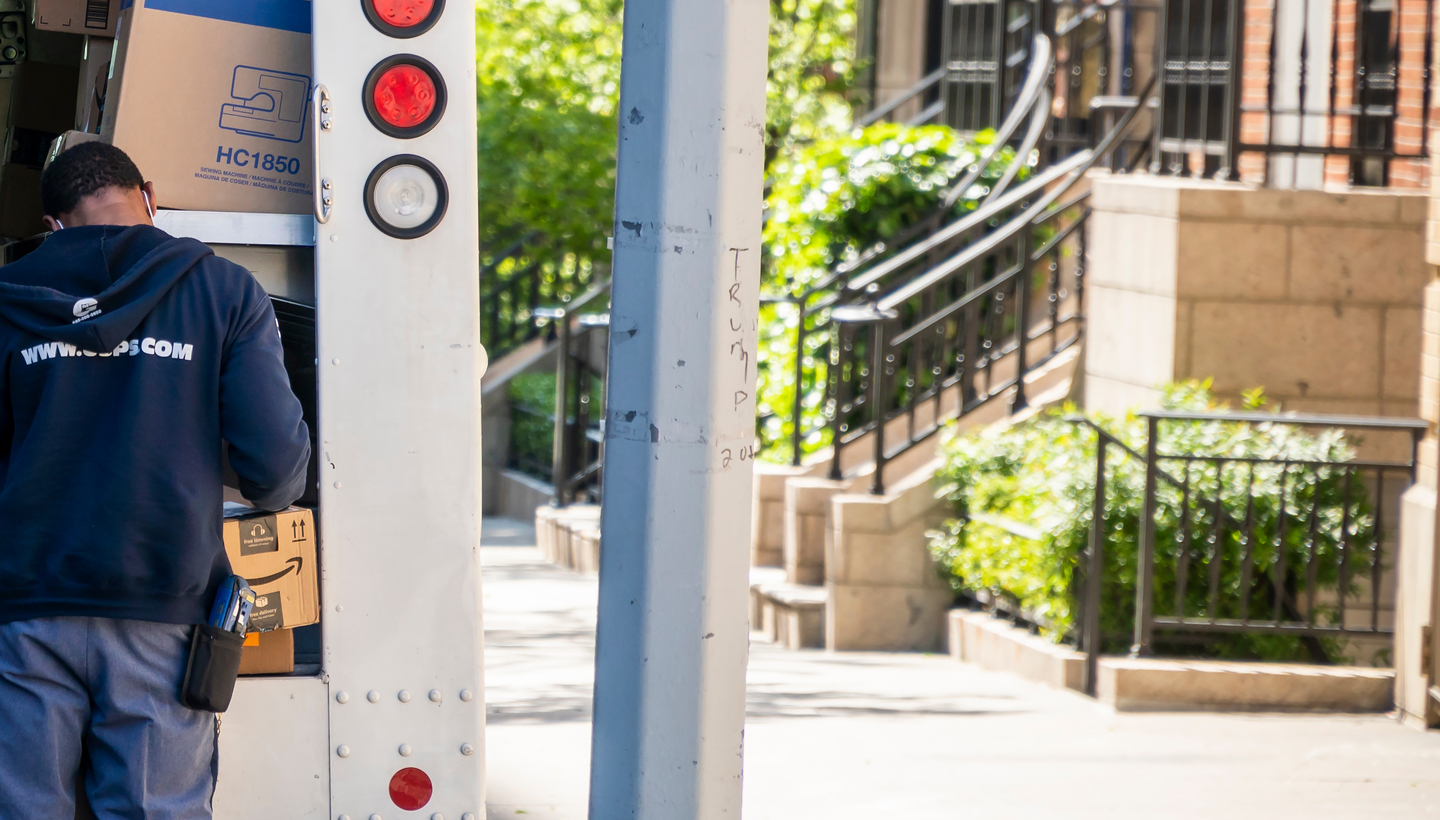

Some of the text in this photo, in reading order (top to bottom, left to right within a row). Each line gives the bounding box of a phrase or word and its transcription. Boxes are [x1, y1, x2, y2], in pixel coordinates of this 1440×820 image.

[216, 145, 301, 175] HC1850
[200, 167, 222, 175] SEWING
[223, 171, 248, 179] MACHINE
[252, 175, 277, 183] MACHINE
[283, 180, 306, 189] COUDRE
